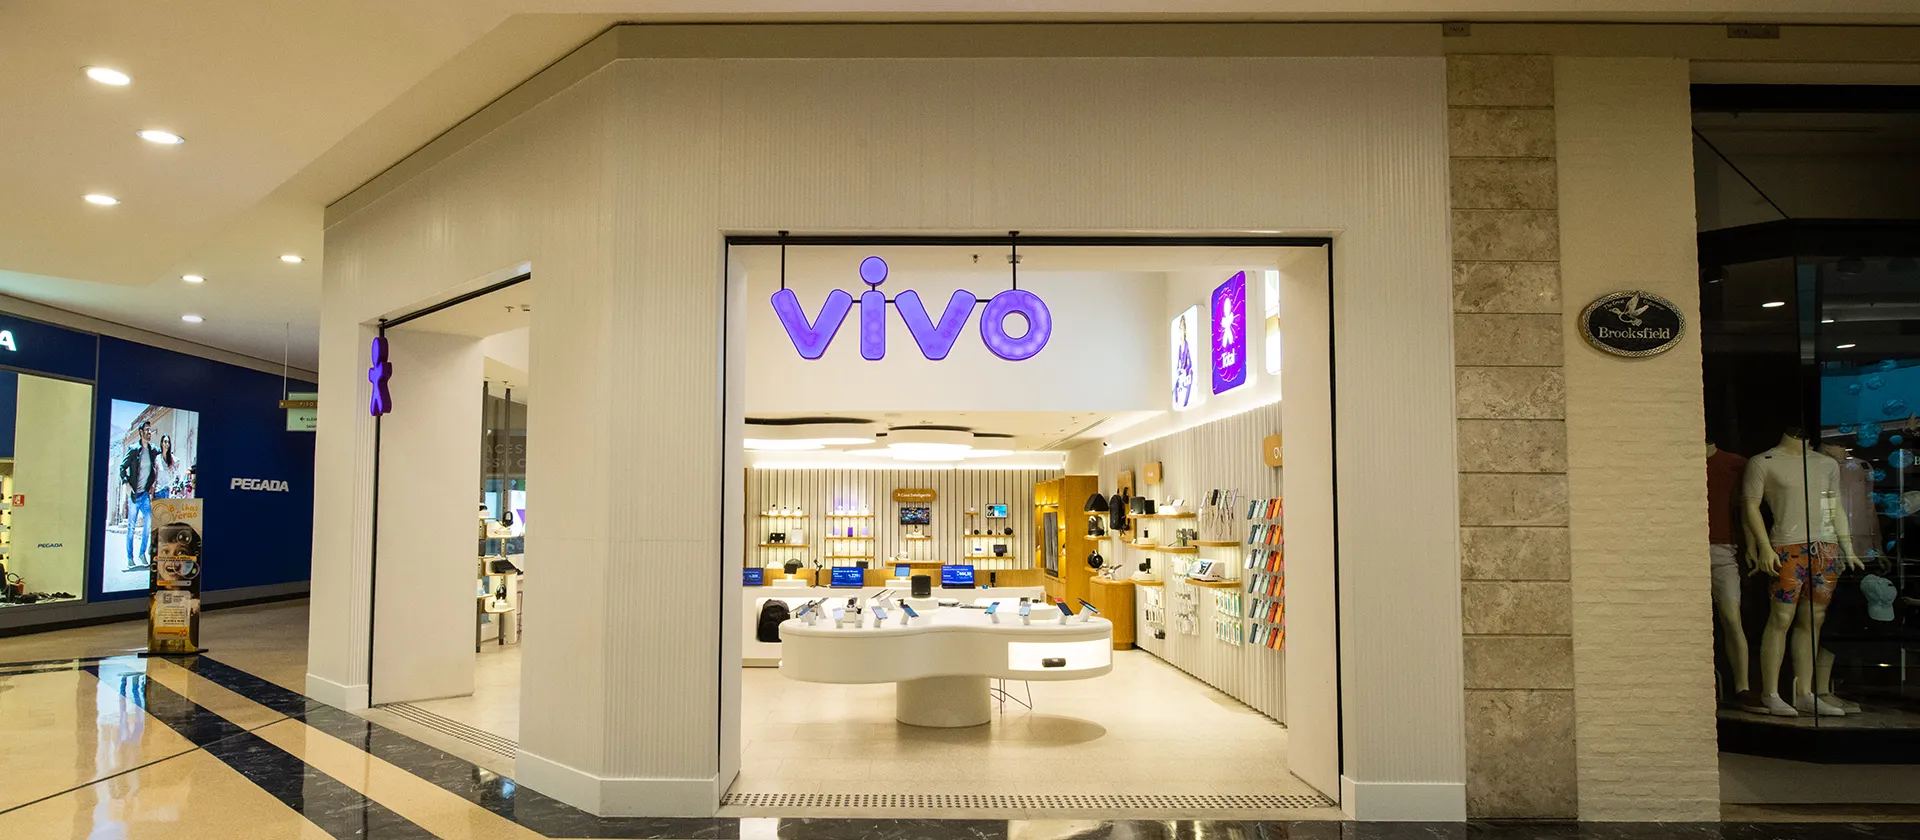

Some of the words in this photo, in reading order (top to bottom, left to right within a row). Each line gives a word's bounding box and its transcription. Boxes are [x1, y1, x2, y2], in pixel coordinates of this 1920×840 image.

[770, 256, 1052, 361] vivo
[1598, 327, 1670, 339] Brooksfield
[230, 477, 289, 492] PEGADA
